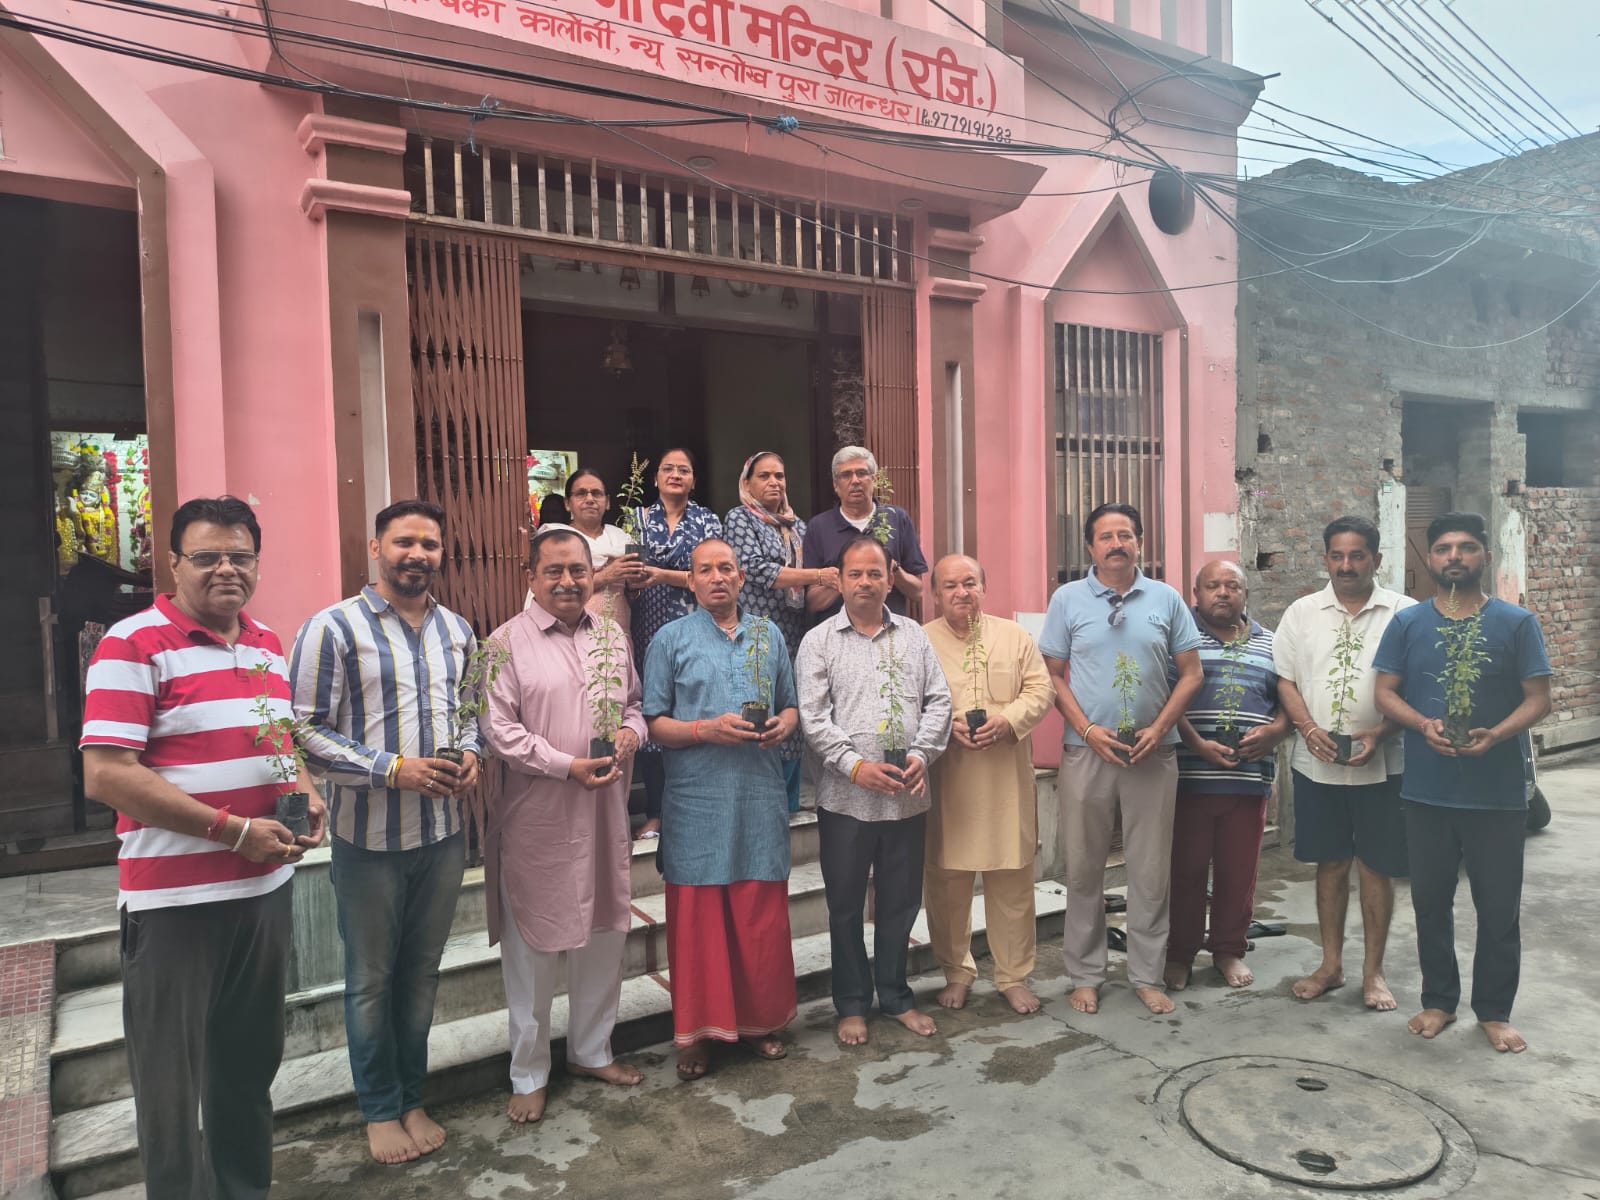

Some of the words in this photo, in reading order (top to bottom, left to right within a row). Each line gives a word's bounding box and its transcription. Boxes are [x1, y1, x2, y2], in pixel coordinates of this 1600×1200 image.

[739, 4, 873, 81] मन्दिर
[776, 72, 821, 103] पुरा
[932, 111, 1012, 144] 9779191283
